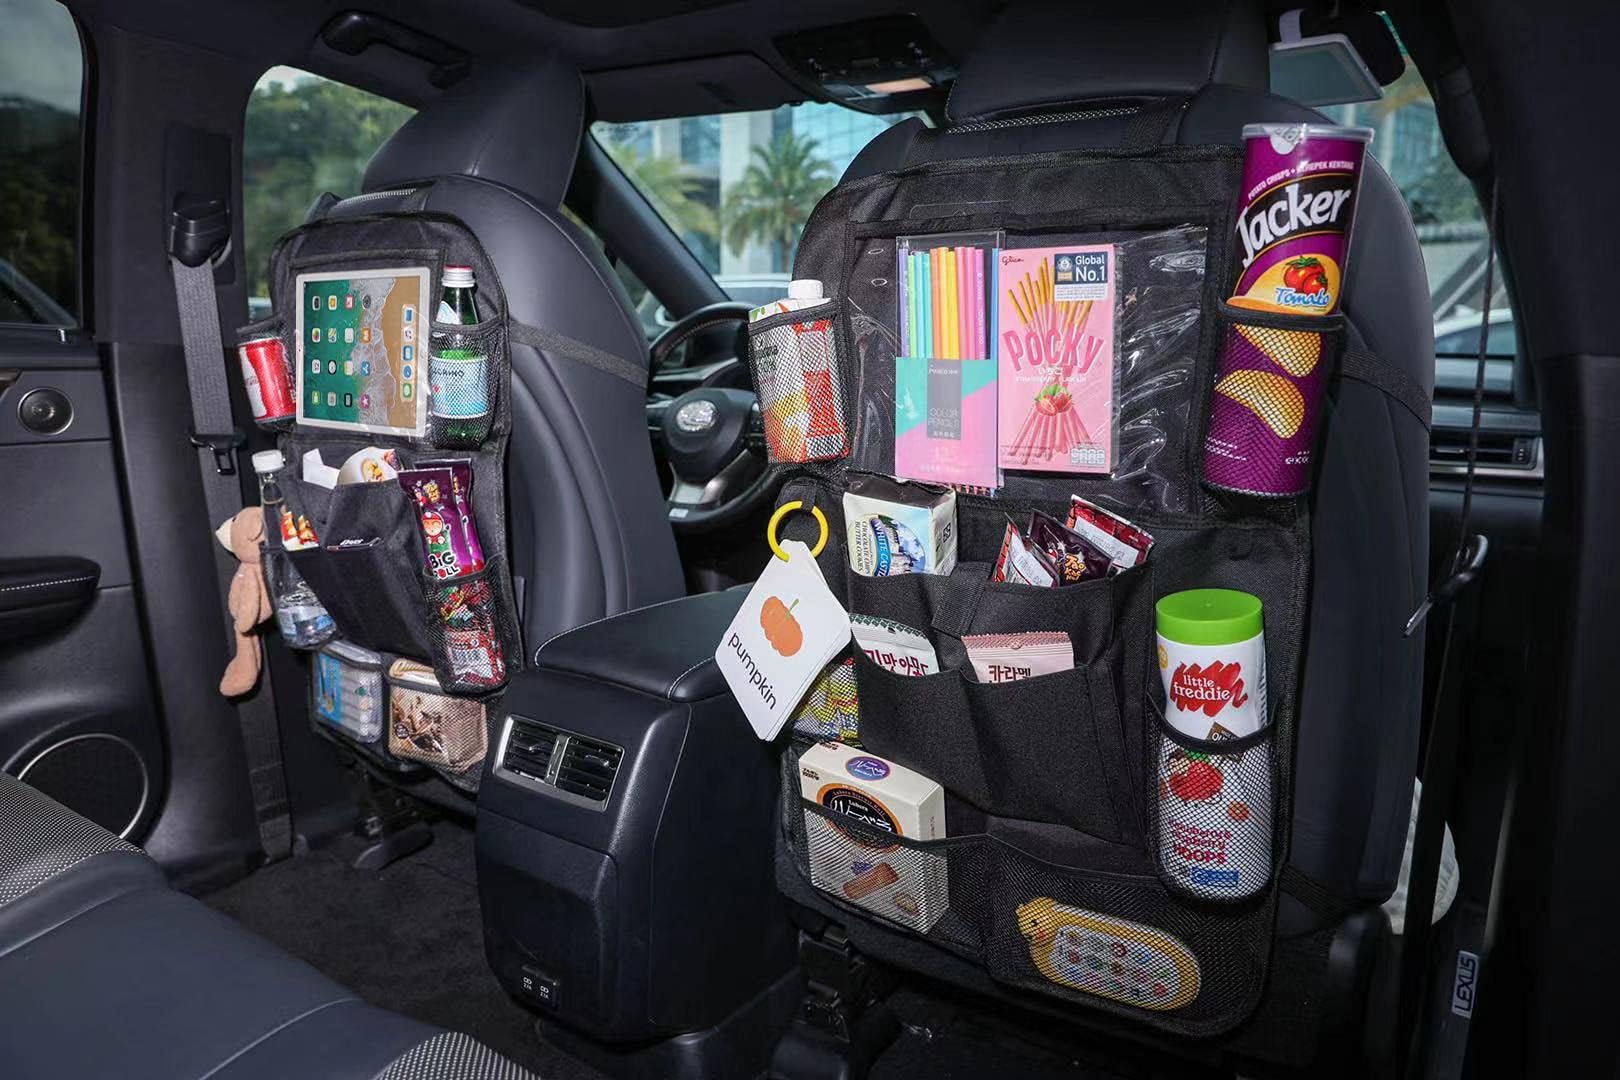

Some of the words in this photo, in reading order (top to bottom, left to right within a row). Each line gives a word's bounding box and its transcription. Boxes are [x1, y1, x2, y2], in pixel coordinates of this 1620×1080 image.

[1296, 160, 1329, 174] EREPEK
[1236, 183, 1352, 269] Jacker
[1075, 254, 1105, 265] Global
[1075, 266, 1105, 282] No.1
[1274, 287, 1332, 306] Tomato
[1002, 328, 1105, 375] POCKY
[873, 521, 888, 552] WHITE
[727, 632, 777, 710] pumpkin
[1183, 674, 1215, 688] little
[1173, 681, 1232, 701] freddie
[1454, 956, 1476, 1013] LEXUS
